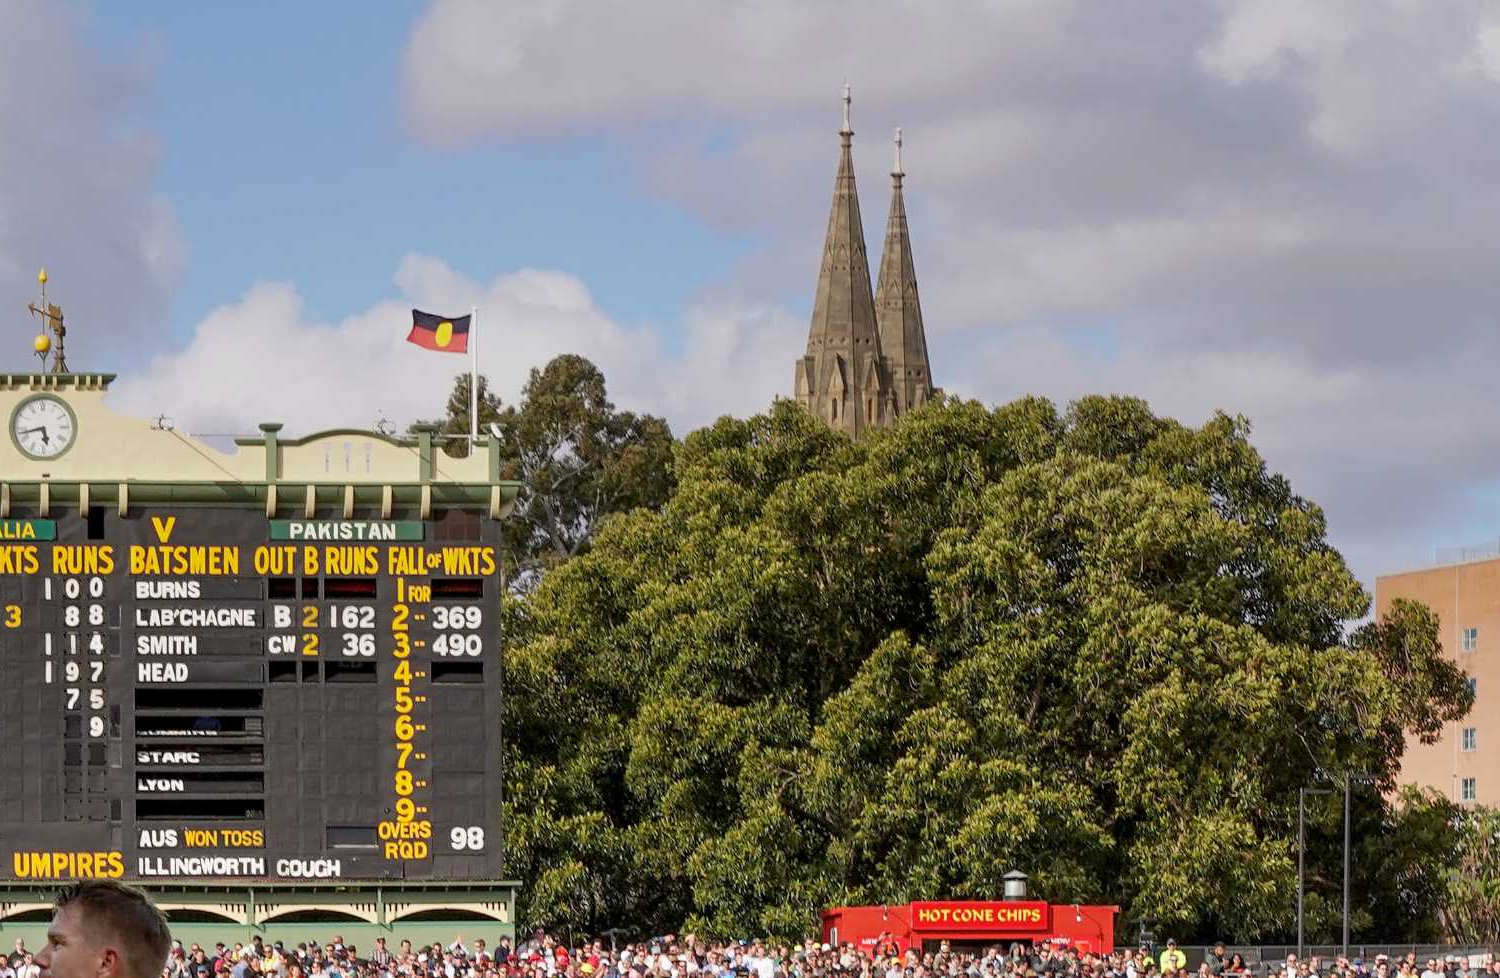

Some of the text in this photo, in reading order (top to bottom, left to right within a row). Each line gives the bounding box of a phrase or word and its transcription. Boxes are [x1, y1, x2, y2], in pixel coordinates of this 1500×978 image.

[152, 516, 177, 543] V
[289, 523, 397, 540] PAKISTAN
[53, 545, 115, 574] RUNS
[130, 546, 496, 575] BATSMEN OUT B RUNS FALL OF WKTS
[135, 581, 201, 599] BURNS
[408, 585, 431, 603] FOR
[5, 605, 22, 628] 3
[136, 608, 256, 627] LAB'CHAGNE
[274, 605, 291, 628] B
[302, 606, 319, 628] 2
[330, 605, 375, 629] 162
[432, 606, 482, 629] 369
[137, 636, 197, 656] SMITH
[268, 635, 297, 654] CW
[302, 633, 319, 657] 2
[342, 633, 376, 657] 36
[432, 634, 483, 657] 490
[138, 663, 188, 682] HEAD
[90, 716, 104, 737] 9
[137, 751, 200, 764] STARC
[138, 779, 184, 791] LYON
[140, 820, 484, 850] AUS WON TOSS OVERS 98
[14, 851, 124, 878] UMPIRES
[138, 857, 341, 877] ILLINGWORTH GOUGH
[919, 908, 1041, 922] HOT CONE CHIPS
